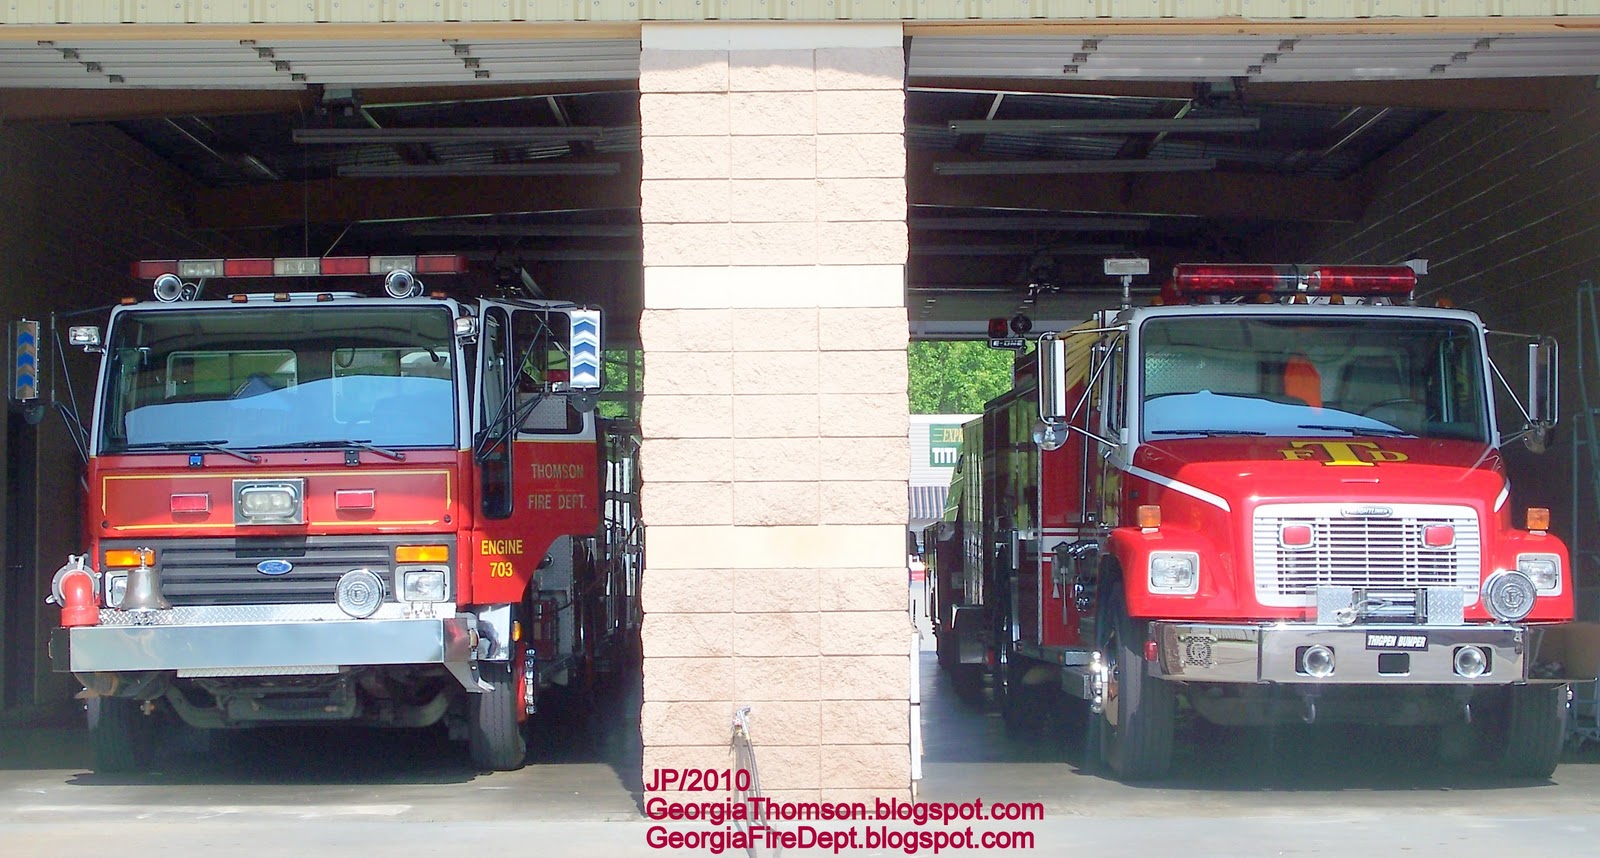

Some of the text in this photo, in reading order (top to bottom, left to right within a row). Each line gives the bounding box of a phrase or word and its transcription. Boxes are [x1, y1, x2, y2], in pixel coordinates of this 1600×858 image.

[531, 463, 584, 479] THOMSON
[528, 494, 588, 510] FIRE DEPT.
[481, 539, 524, 555] ENGINE
[489, 562, 514, 578] 703
[1397, 635, 1427, 648] BUMPER
